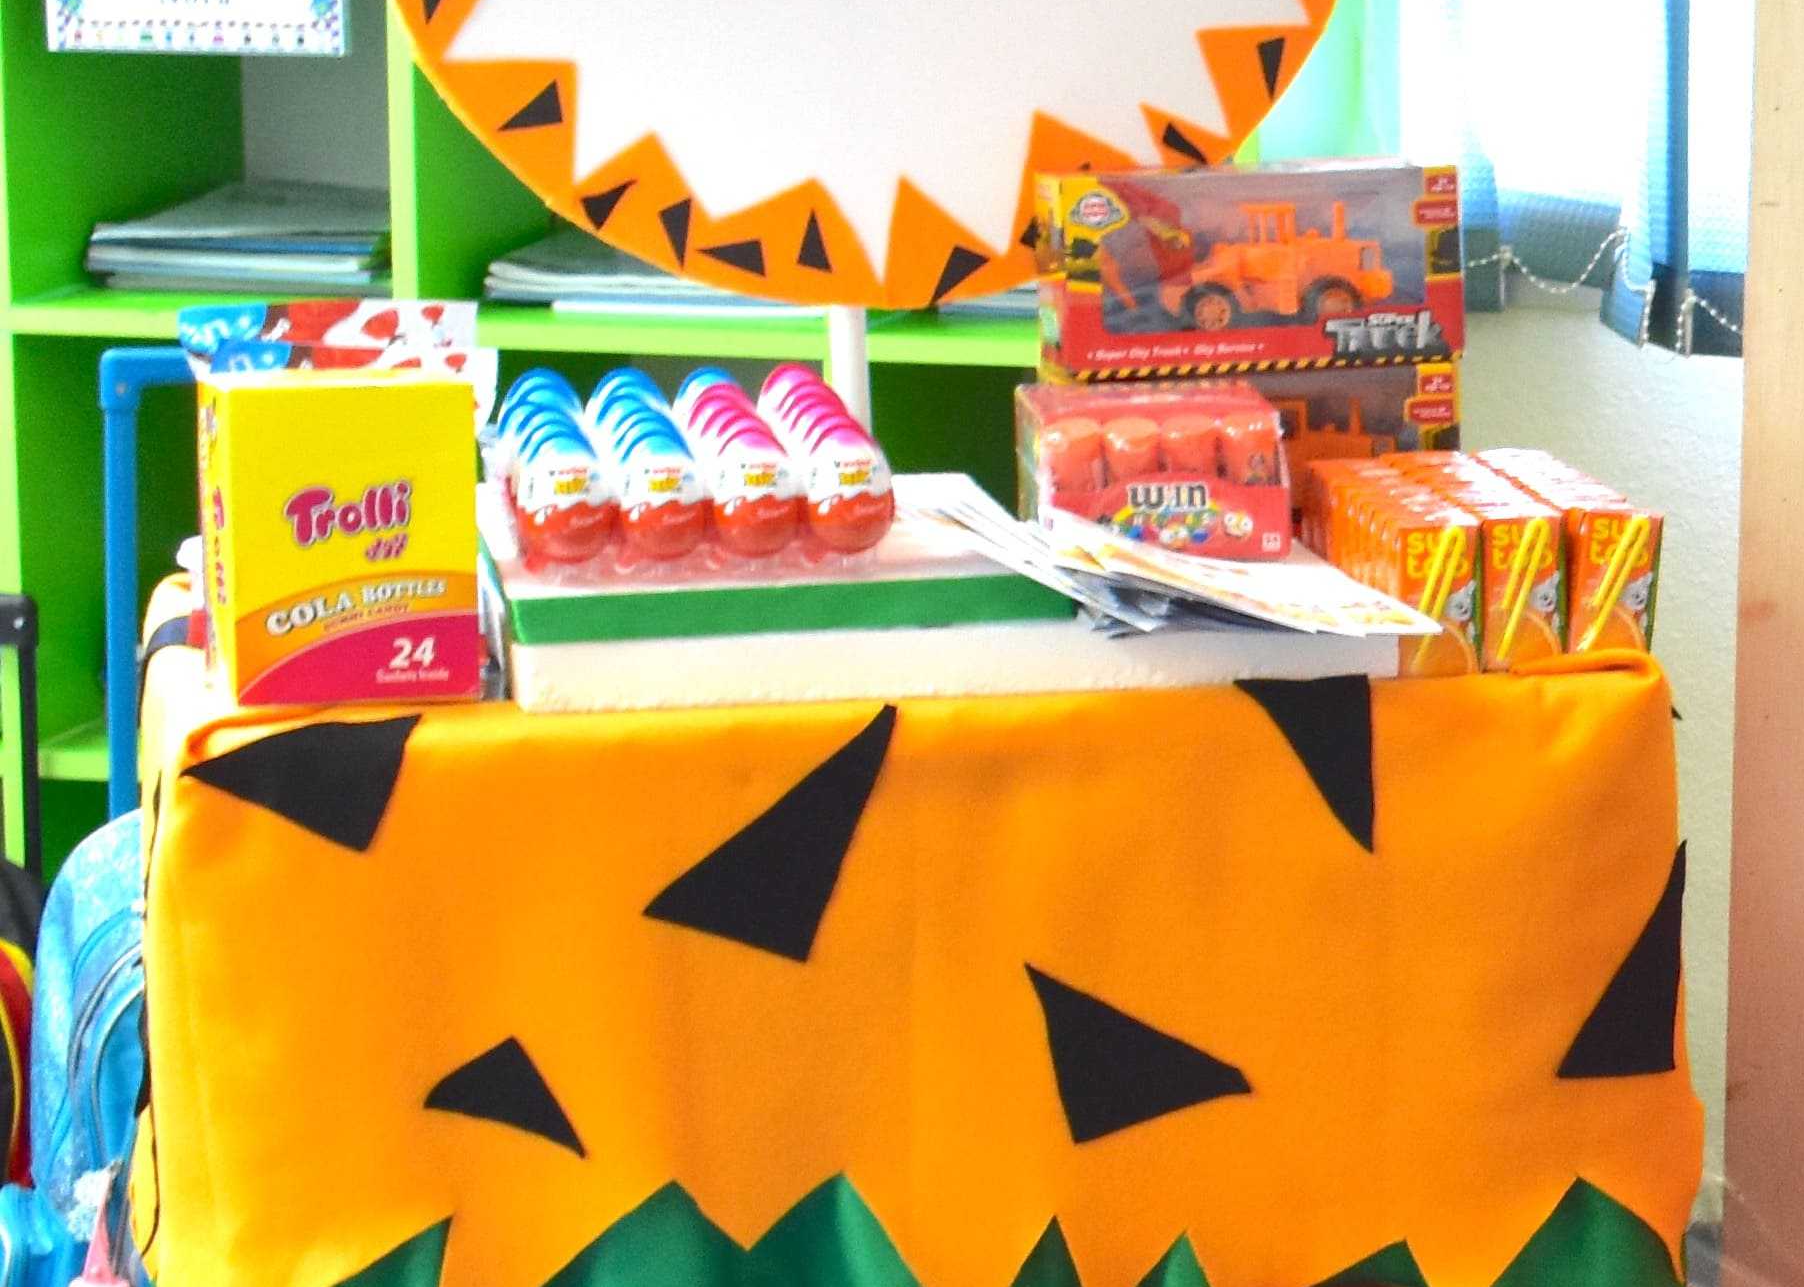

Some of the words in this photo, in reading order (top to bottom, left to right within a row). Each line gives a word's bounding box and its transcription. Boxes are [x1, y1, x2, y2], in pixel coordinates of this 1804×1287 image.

[285, 481, 411, 547] Trolli
[266, 591, 352, 636] COLA
[361, 579, 446, 603] BOTTLES
[388, 637, 434, 669] 24
